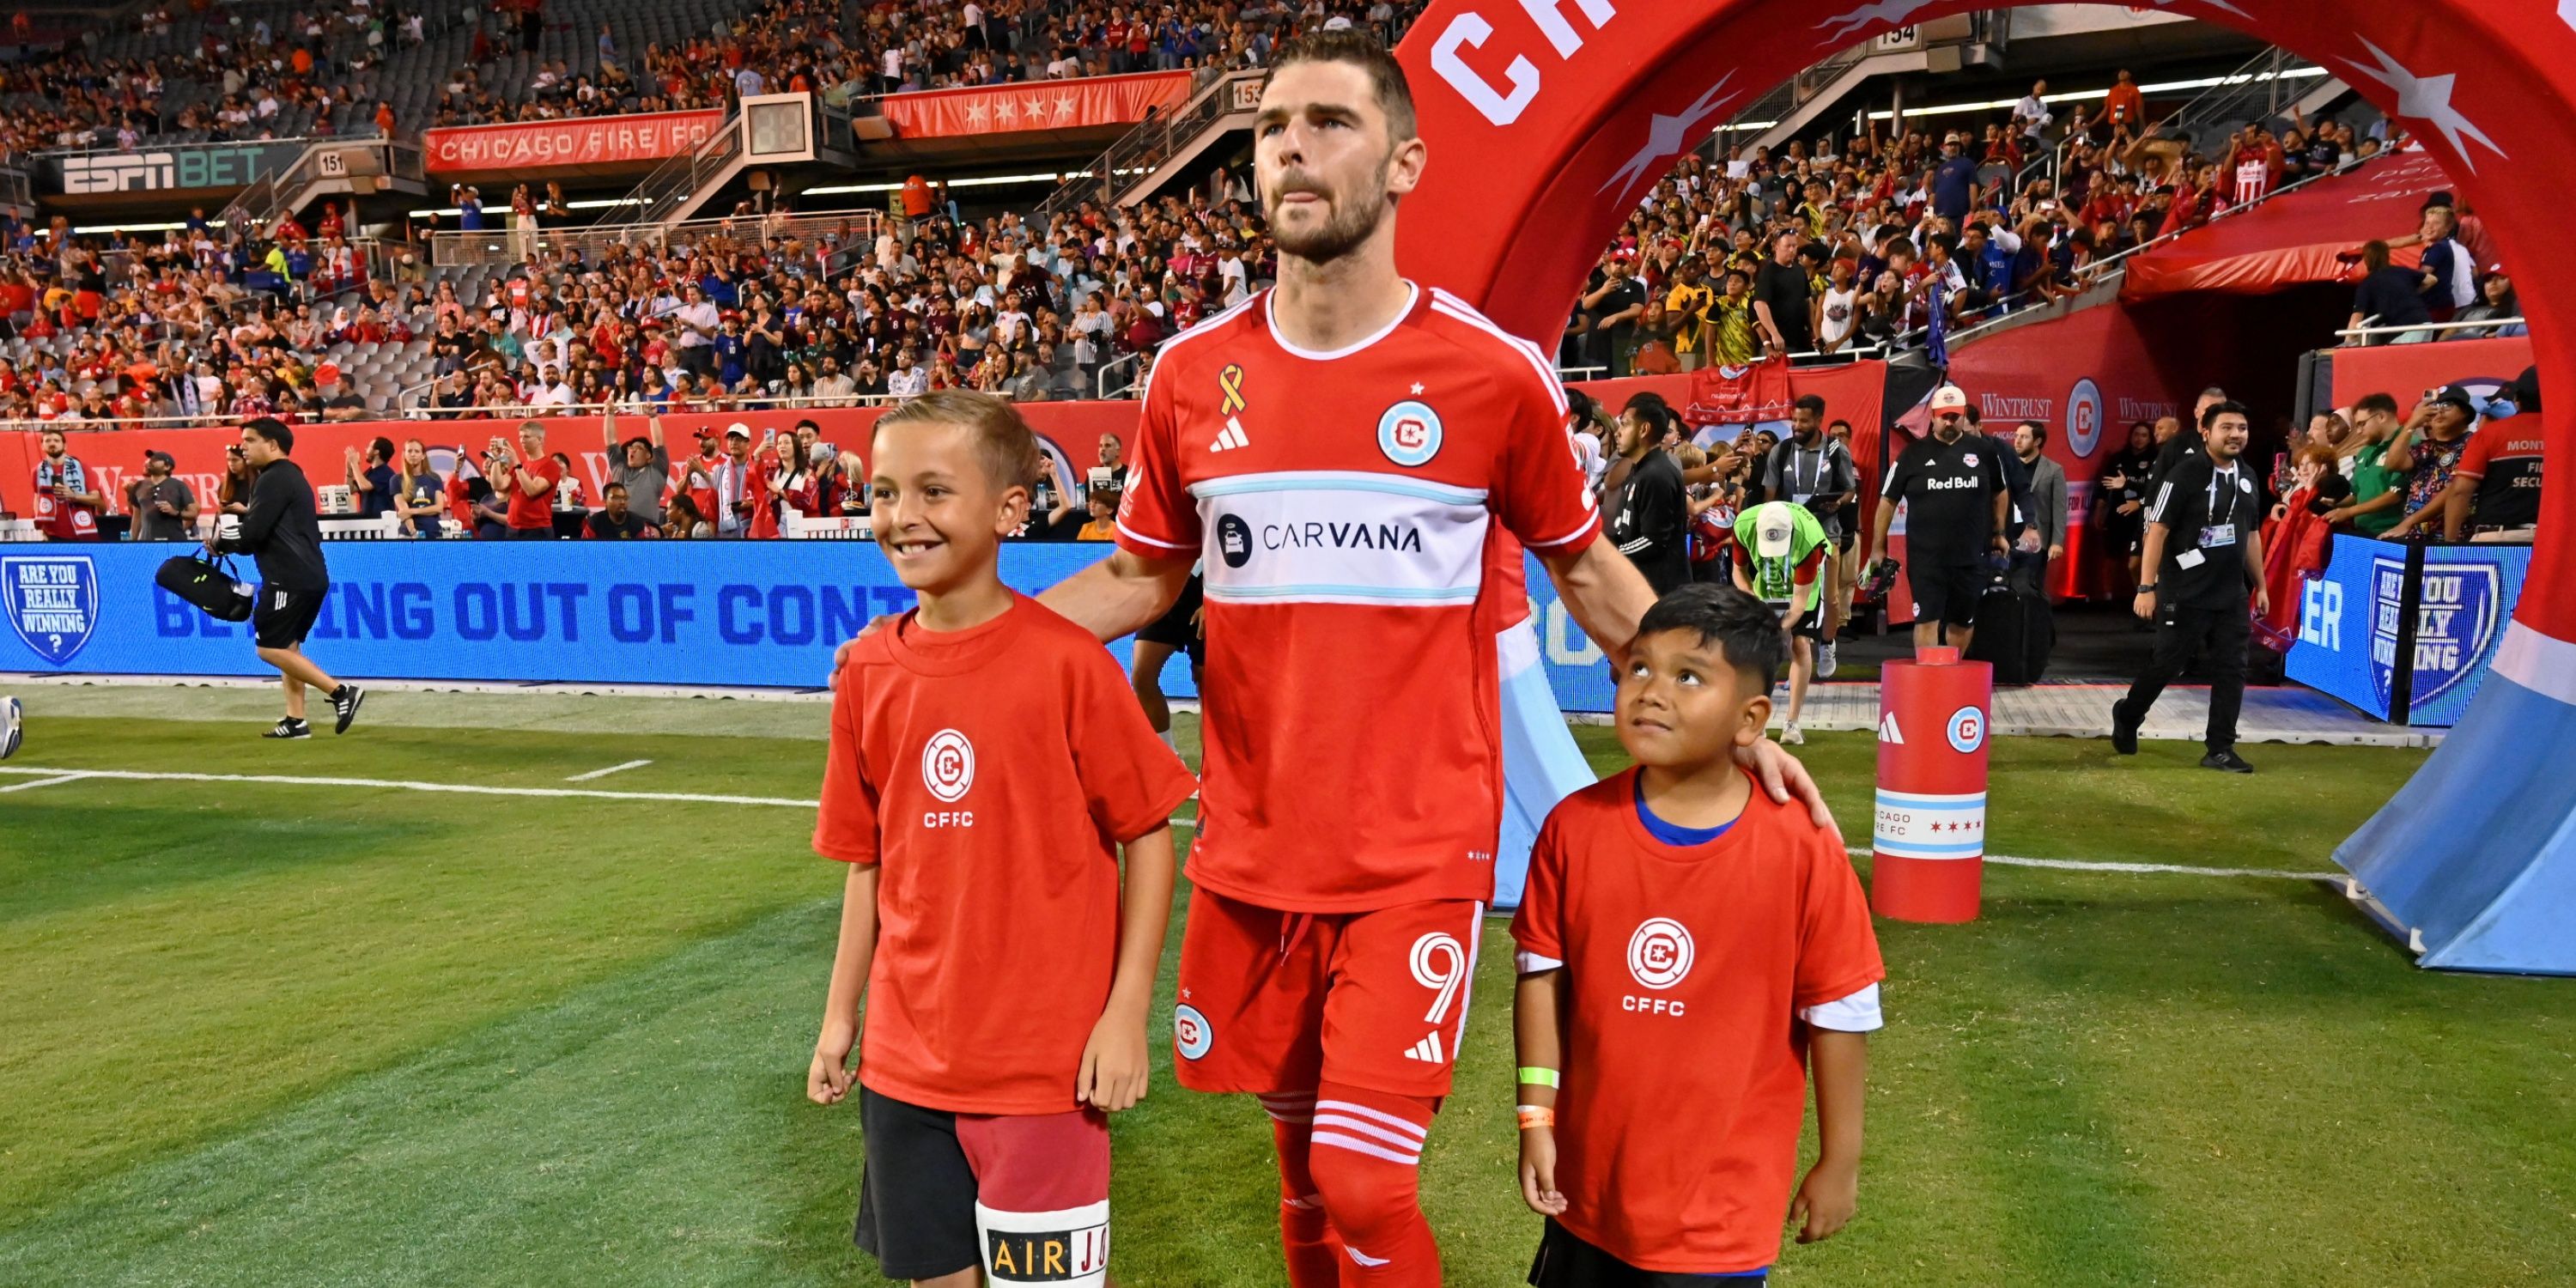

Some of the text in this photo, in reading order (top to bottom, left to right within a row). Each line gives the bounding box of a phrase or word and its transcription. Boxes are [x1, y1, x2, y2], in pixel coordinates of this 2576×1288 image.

[441, 125, 707, 161] CHICAGO FIRE FC
[64, 149, 264, 194] ESPN BET
[323, 155, 343, 171] 151
[1981, 393, 2052, 417] WINTRUST
[1993, 431, 2018, 440] CHICAG
[1927, 476, 1978, 490] Red Bull
[2512, 477, 2543, 488] SECU
[1264, 522, 1421, 552] CARVANA
[18, 564, 76, 584] ARE YOU
[2380, 571, 2398, 598] ARE
[24, 589, 76, 609] REALLY
[21, 613, 85, 633] WINNING
[153, 581, 434, 640] BING
[453, 582, 588, 642] OUT
[608, 582, 696, 644] OF
[2299, 578, 2342, 653] ER
[49, 634, 62, 653] ?
[924, 811, 974, 829] CFFC
[1890, 825, 1906, 835] FC
[1409, 931, 1465, 1024] 9
[1622, 994, 1685, 1018] CFFC
[994, 1239, 1066, 1275] AIR
